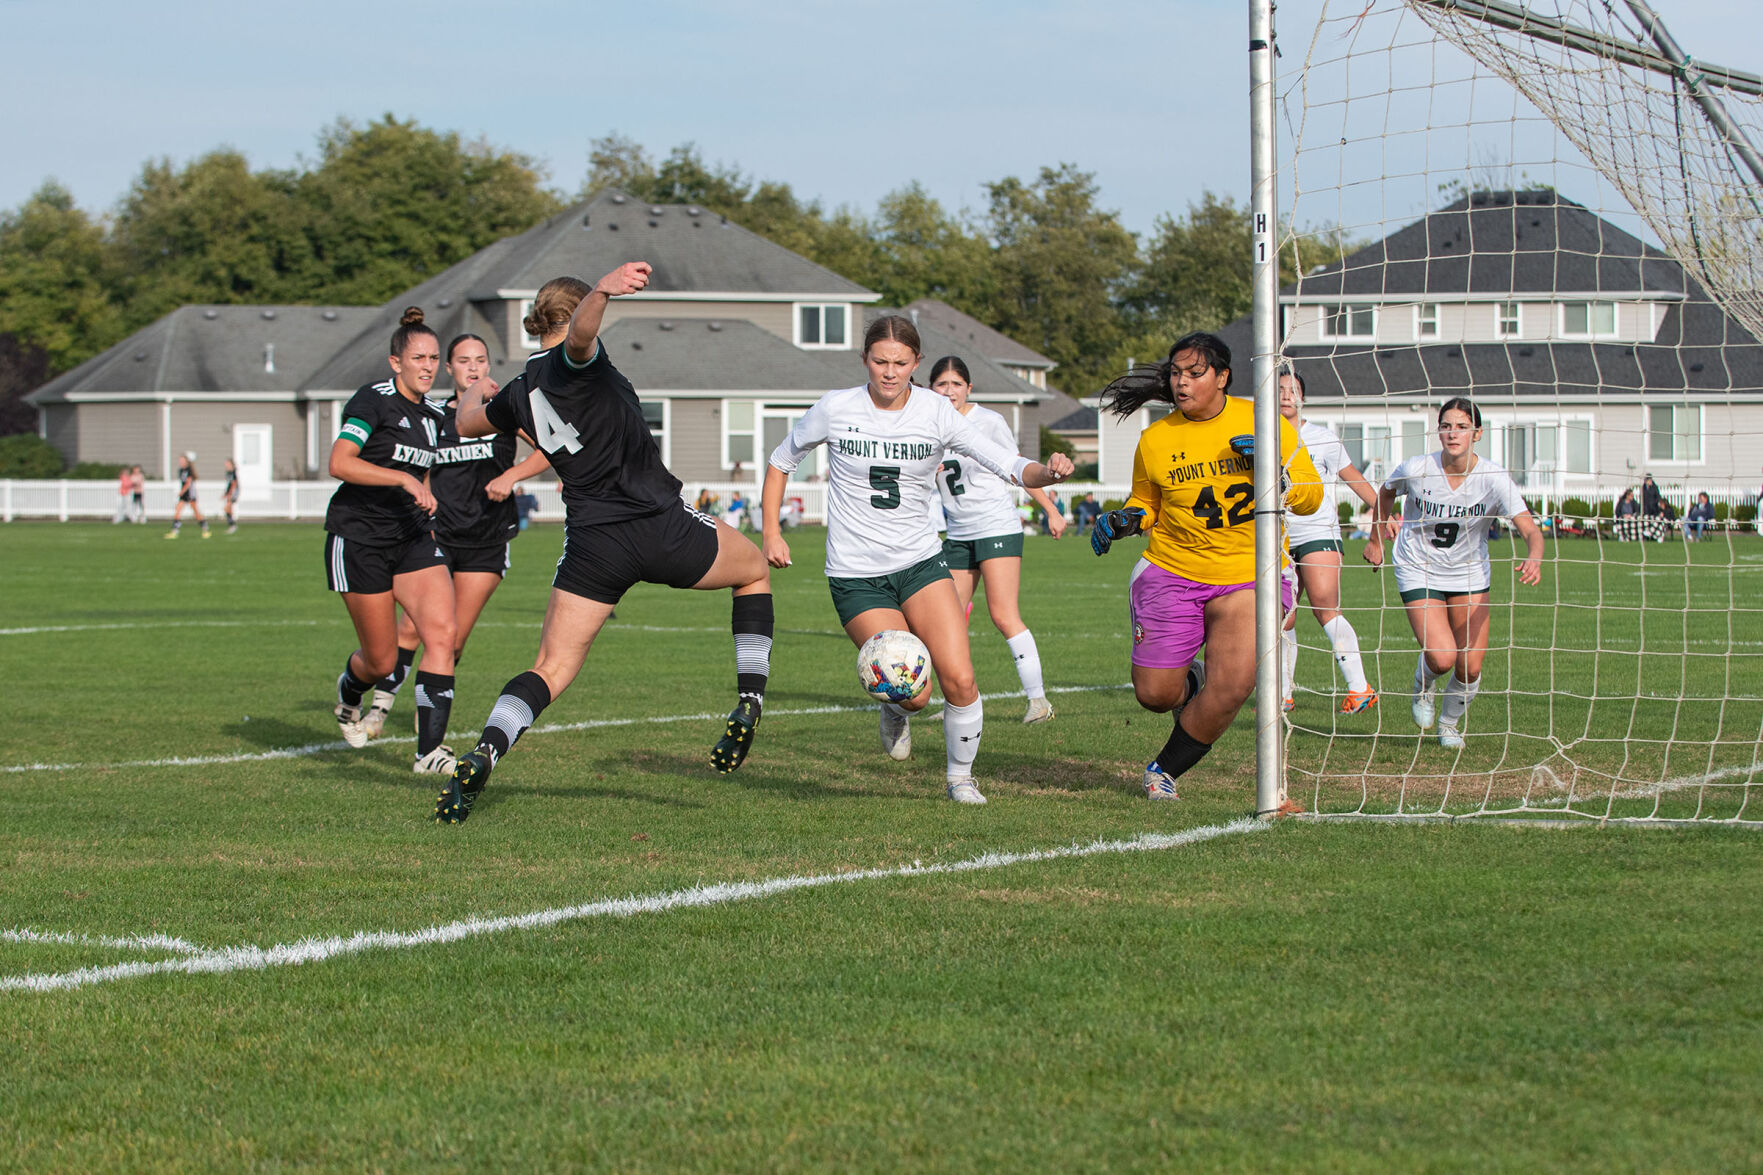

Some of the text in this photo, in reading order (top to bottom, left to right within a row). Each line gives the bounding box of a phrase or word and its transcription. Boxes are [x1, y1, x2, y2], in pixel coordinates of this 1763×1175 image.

[1256, 213, 1266, 233] H
[1258, 242, 1265, 261] 1
[528, 386, 584, 455] 4
[435, 442, 494, 464] LYNDEN
[839, 439, 932, 461] MOUNT VERNON
[941, 459, 966, 496] 2
[1167, 455, 1251, 485] MOUNT VERNO
[869, 465, 901, 509] 5
[1192, 482, 1255, 529] 42
[1431, 522, 1460, 548] 9
